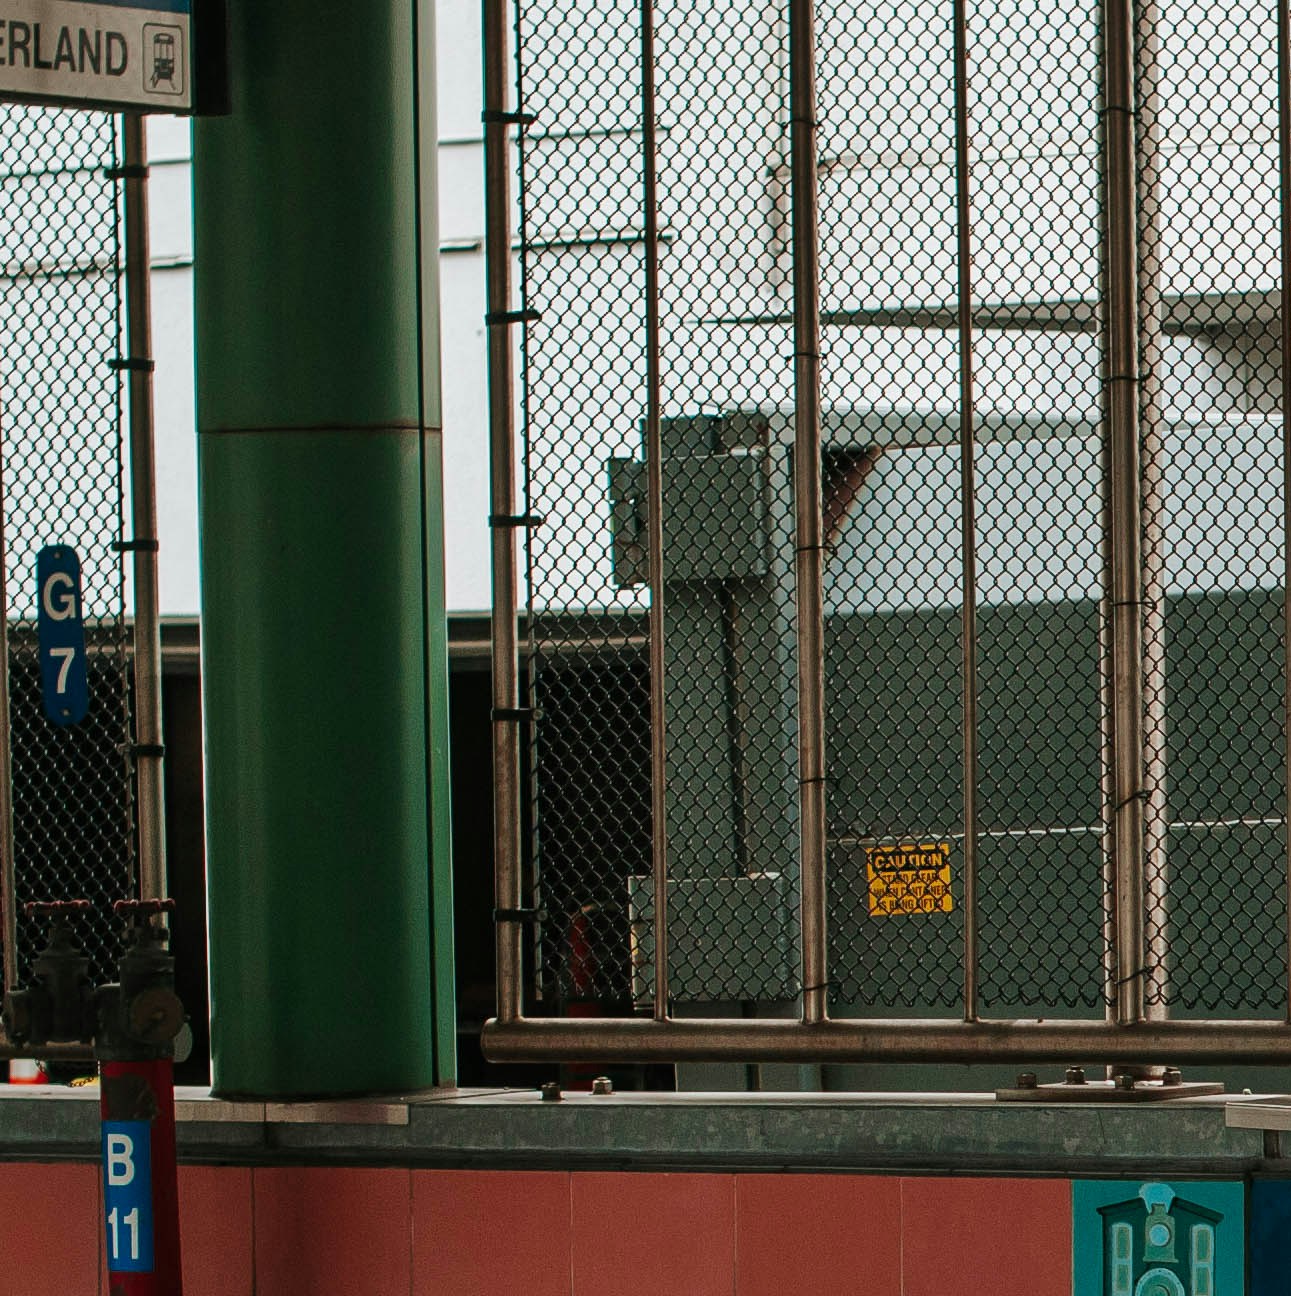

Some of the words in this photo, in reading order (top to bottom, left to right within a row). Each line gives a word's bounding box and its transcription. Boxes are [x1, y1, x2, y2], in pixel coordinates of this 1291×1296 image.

[0, 20, 128, 76] RLAND
[43, 571, 77, 621] G
[50, 647, 75, 694] 7
[107, 1133, 135, 1186] B
[108, 1207, 139, 1260] 11
